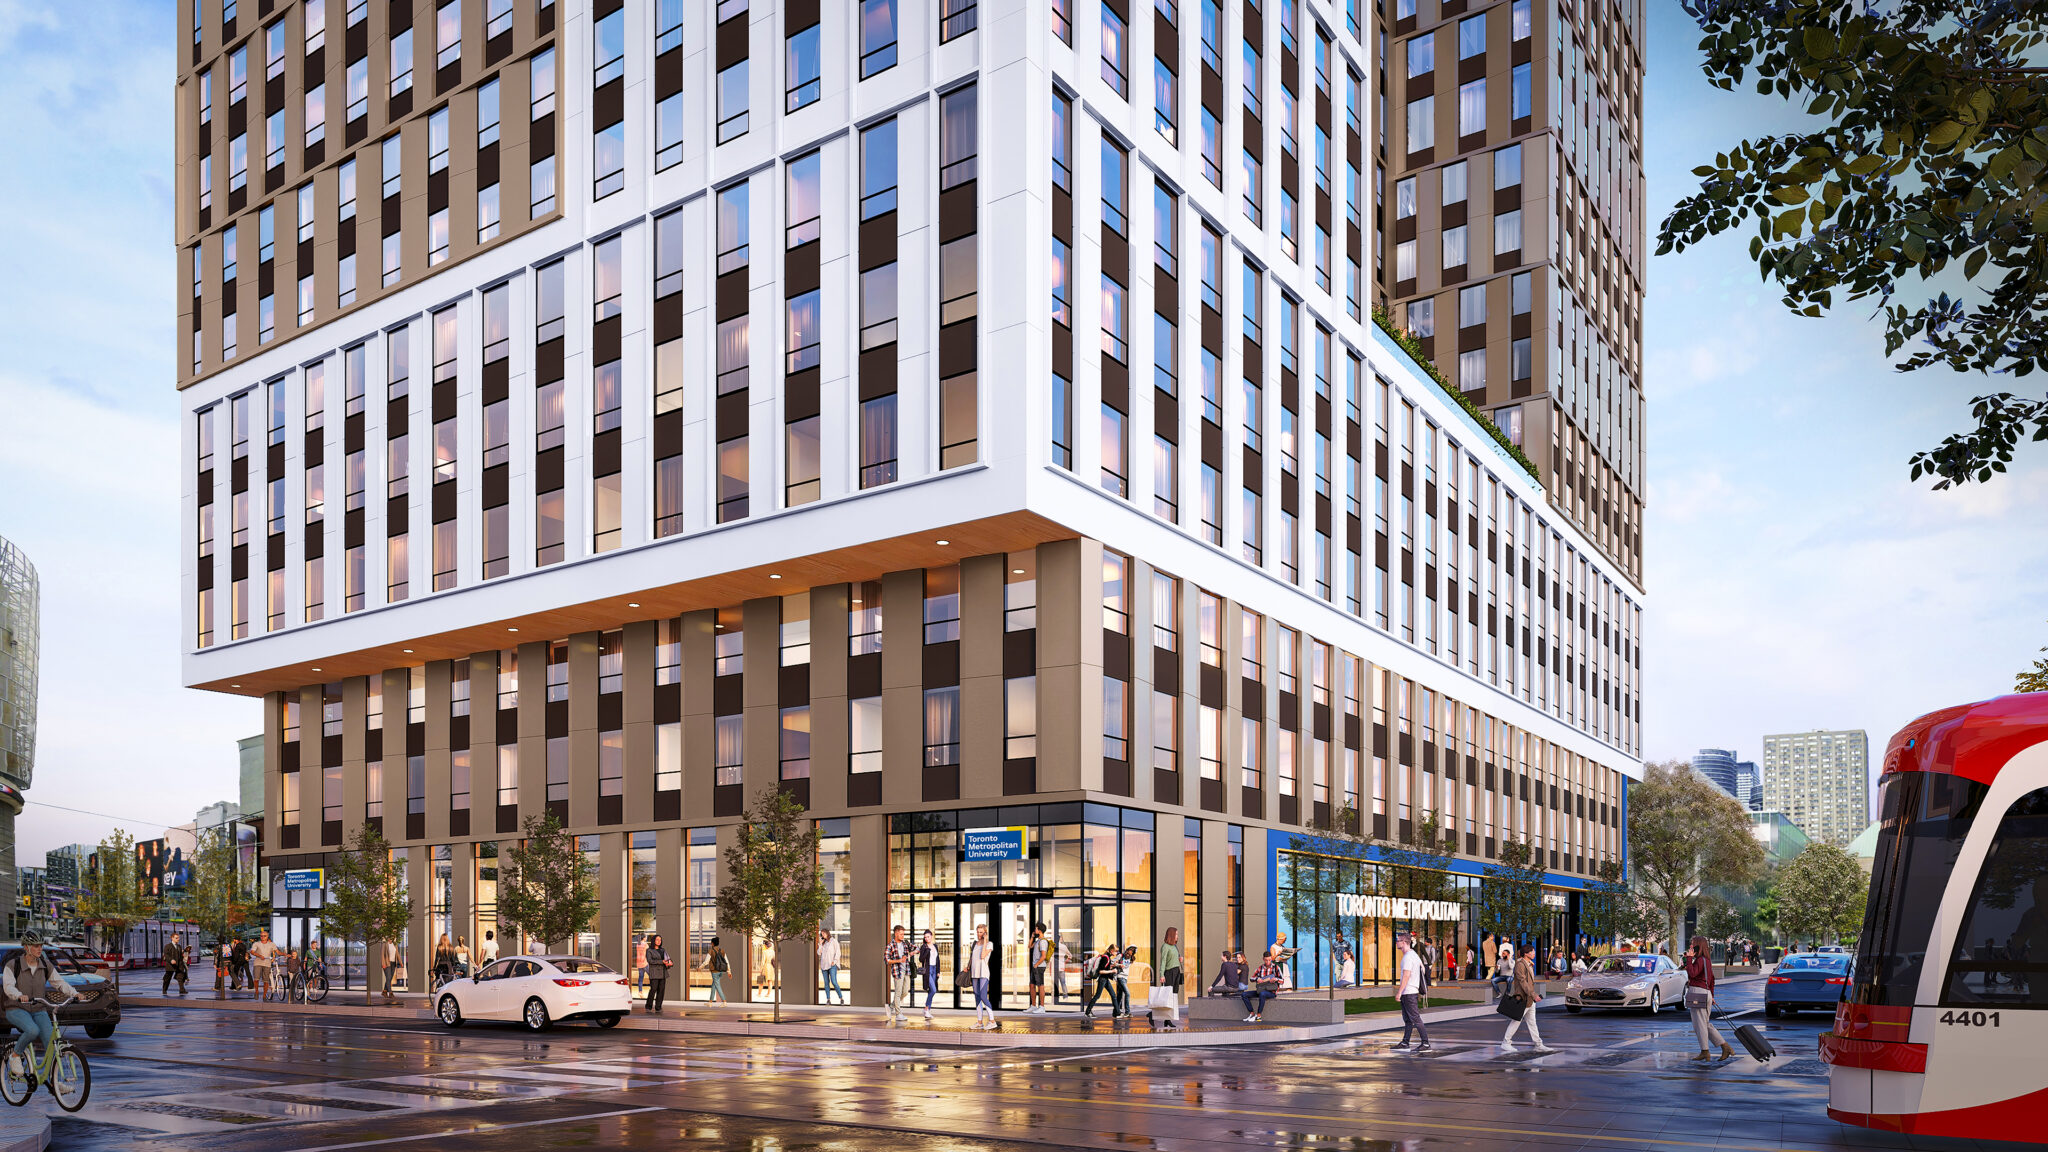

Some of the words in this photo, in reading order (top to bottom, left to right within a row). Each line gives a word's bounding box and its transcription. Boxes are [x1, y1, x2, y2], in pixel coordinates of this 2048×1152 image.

[968, 842, 1018, 850] Metropolitan
[968, 850, 1008, 858] University
[1336, 893, 1391, 919] TORONTO
[1392, 897, 1460, 921] METROPOLITAN
[1940, 1011, 2000, 1028] 4401
